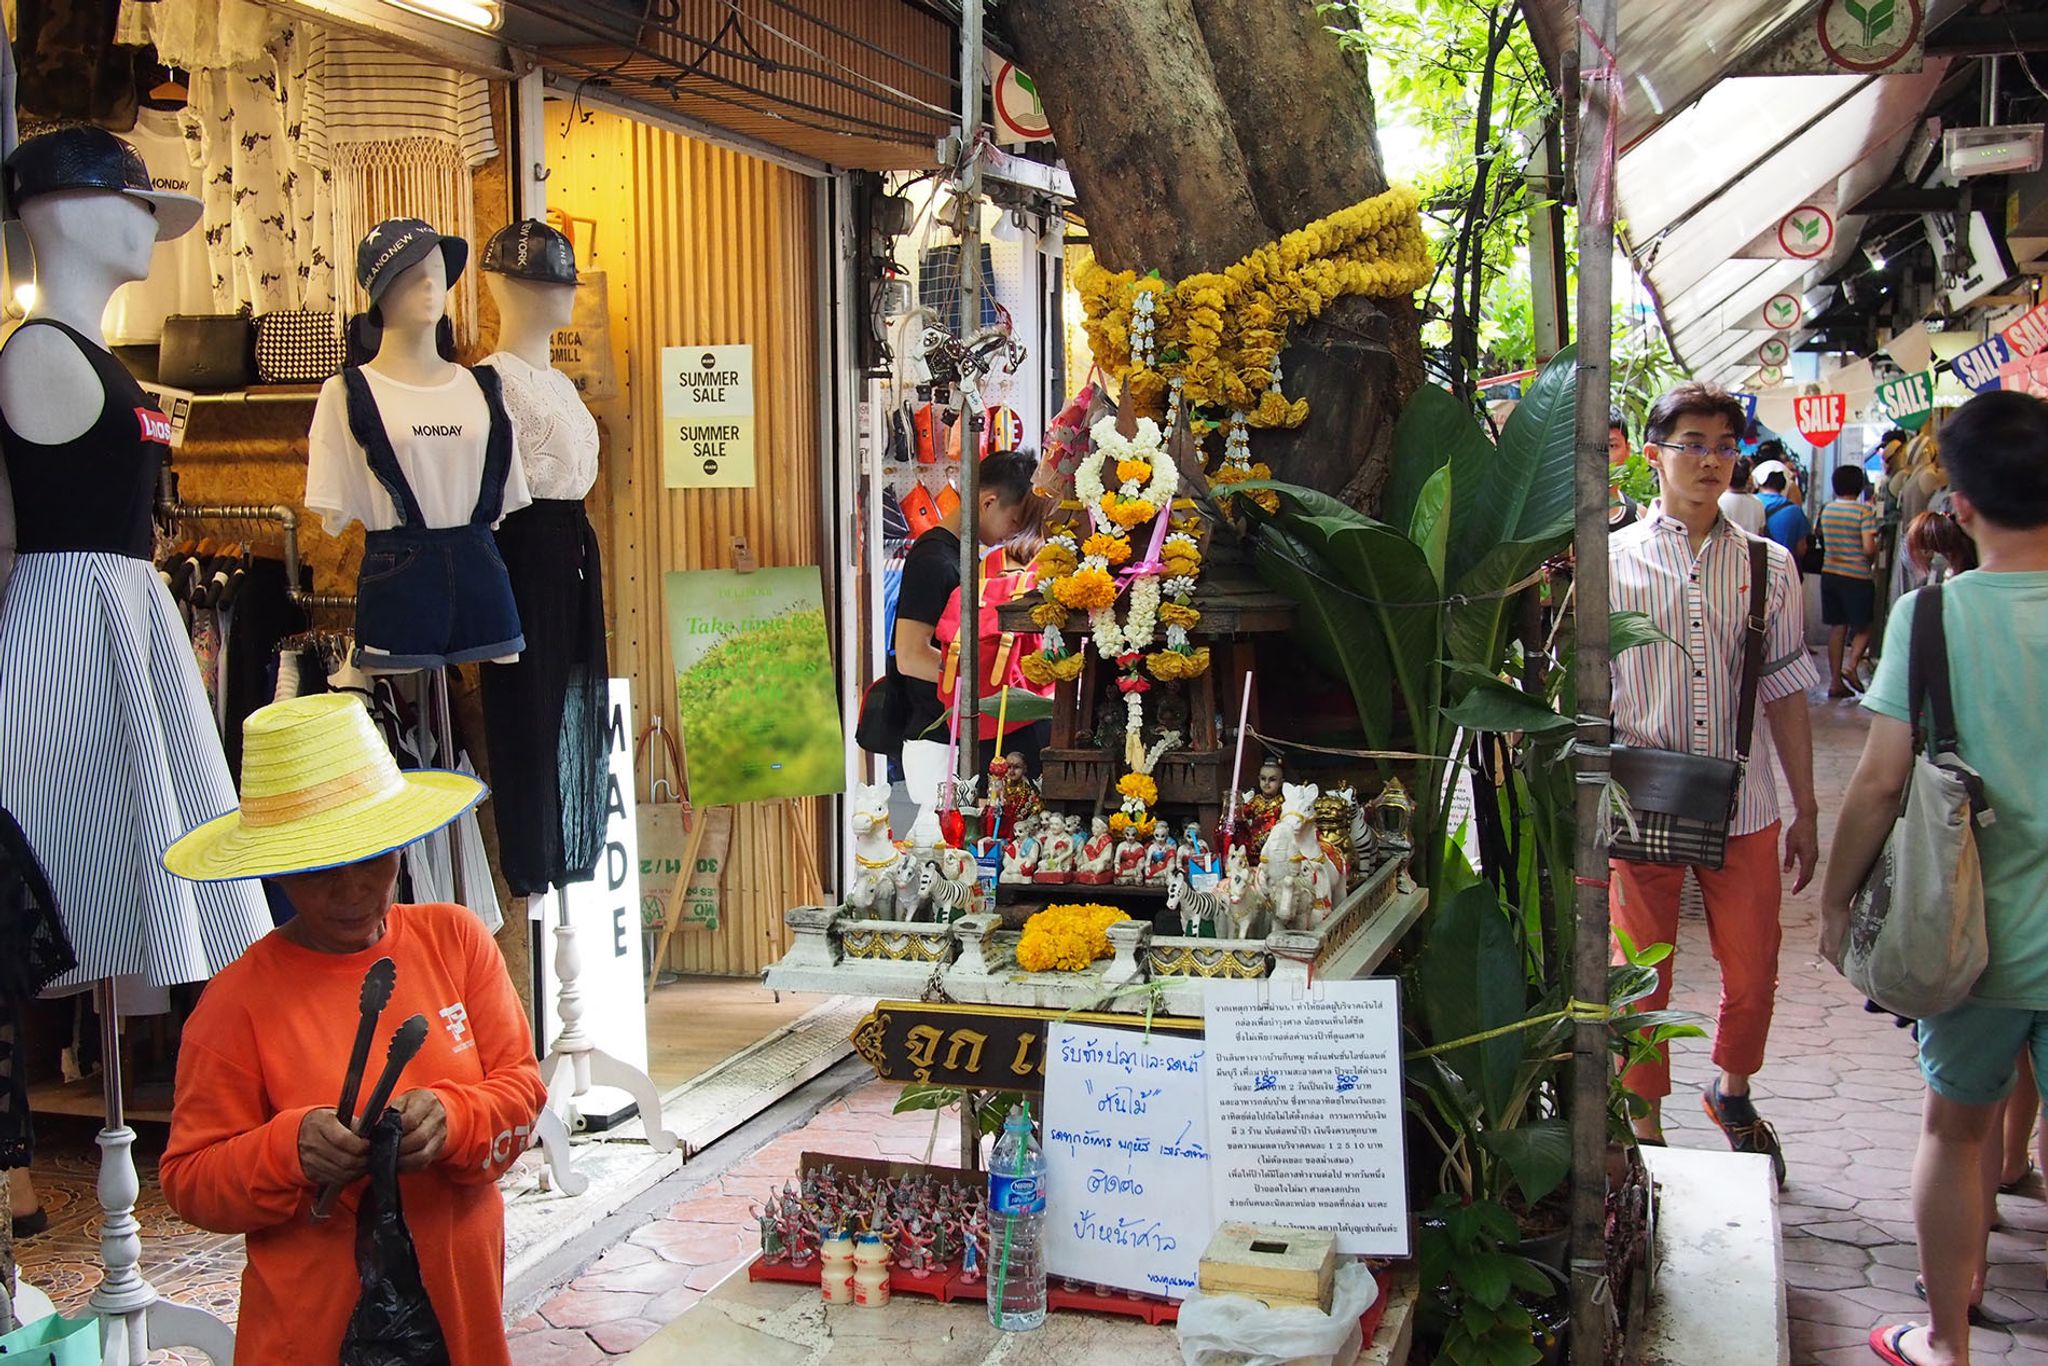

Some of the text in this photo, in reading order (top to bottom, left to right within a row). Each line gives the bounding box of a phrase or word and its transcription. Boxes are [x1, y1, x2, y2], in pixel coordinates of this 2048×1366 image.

[557, 331, 583, 346] RICA
[1957, 340, 2004, 390] SALE
[679, 371, 739, 387] SUMMER
[693, 388, 726, 403] SALE
[1884, 376, 1930, 420] SALE
[1798, 396, 1840, 434] SALE
[412, 424, 462, 436] MONDAY
[679, 426, 740, 441] SUMMER
[693, 442, 726, 457] SALE
[687, 616, 734, 637] Take
